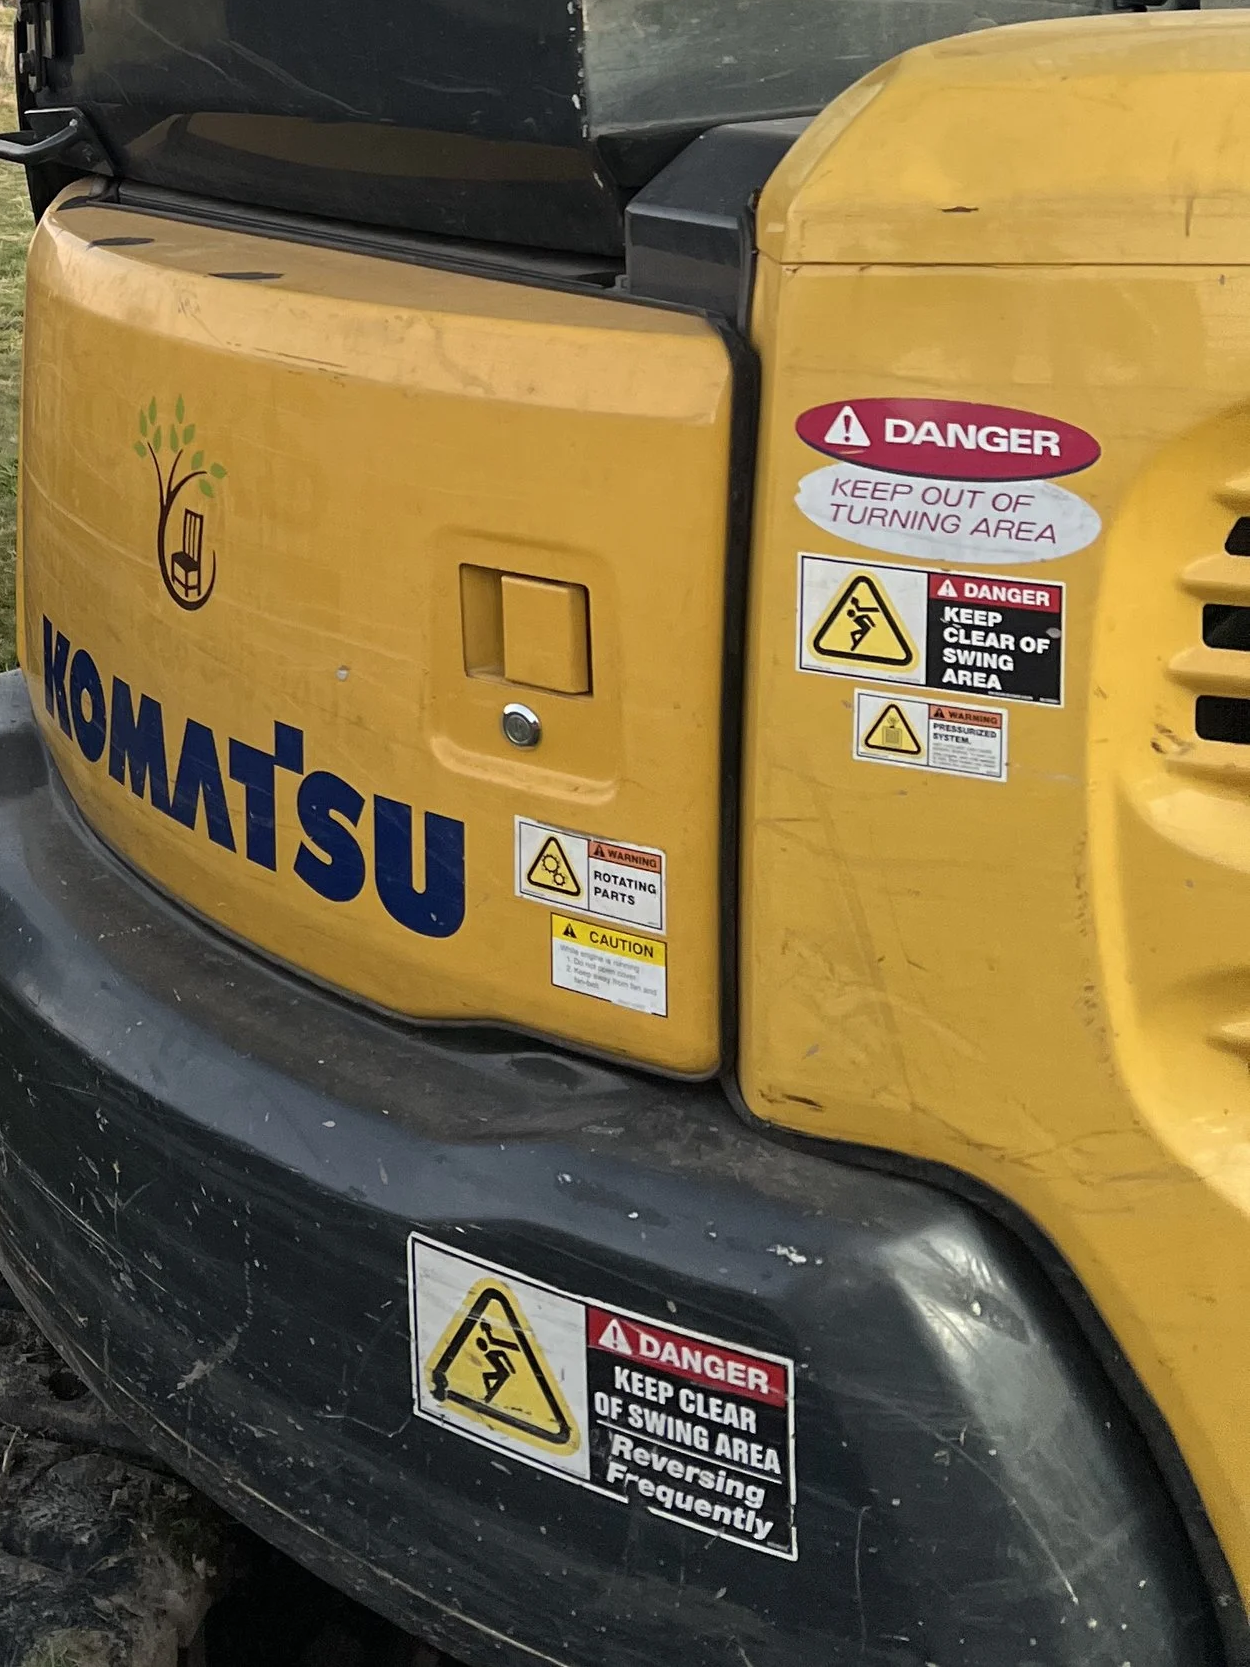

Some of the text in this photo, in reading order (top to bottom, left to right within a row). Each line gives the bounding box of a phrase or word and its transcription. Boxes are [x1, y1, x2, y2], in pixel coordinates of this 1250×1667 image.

[884, 418, 1061, 457] DANGER
[831, 477, 1035, 514] KEEP OUT OF
[830, 503, 1057, 544] TURNING AREA
[963, 582, 1050, 607] DANGER
[943, 606, 1002, 627] KEEP
[943, 627, 1050, 654] CLEAR OF
[942, 648, 1014, 671] SWING
[942, 668, 1002, 690] AREA
[933, 722, 997, 738] PRESSURIZED
[948, 711, 998, 725] WARNING
[42, 614, 466, 939] KOMATSU
[608, 850, 657, 869] WARNING
[593, 870, 657, 895] ROTATING
[594, 887, 636, 905] PARTS
[589, 931, 654, 958] CAUTION
[638, 1333, 770, 1394] DANGER
[614, 1365, 757, 1434] KEEP CLEAR
[594, 1392, 783, 1475] OF SWING AREA
[610, 1433, 766, 1510] Reversing
[606, 1464, 774, 1541] Frequently
